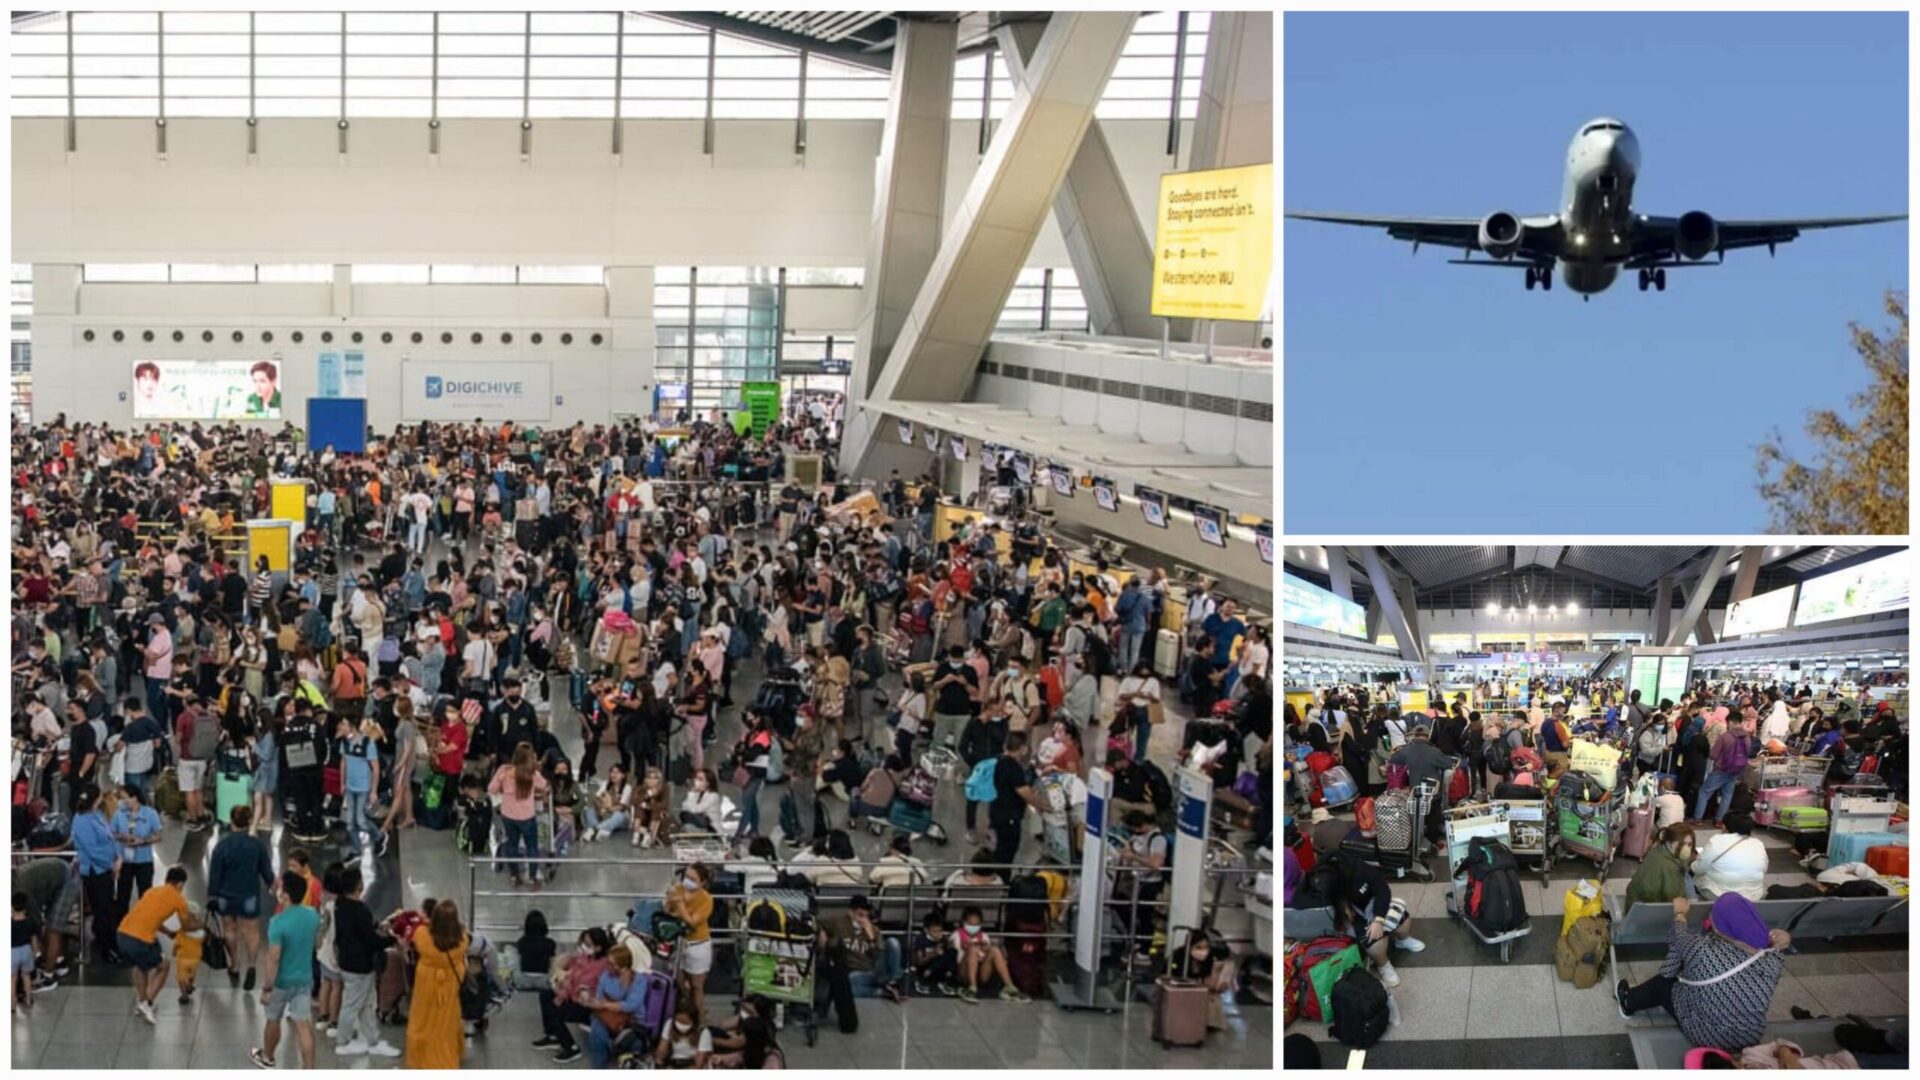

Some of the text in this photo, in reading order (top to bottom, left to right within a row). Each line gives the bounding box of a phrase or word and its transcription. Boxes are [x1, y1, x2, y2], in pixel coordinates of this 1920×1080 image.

[1168, 186, 1238, 205] Goodbyes are hard.
[1167, 207, 1193, 222] Staying
[1194, 204, 1234, 219] connected
[1219, 270, 1234, 285] WU
[446, 381, 523, 394] DIGICHIVE
